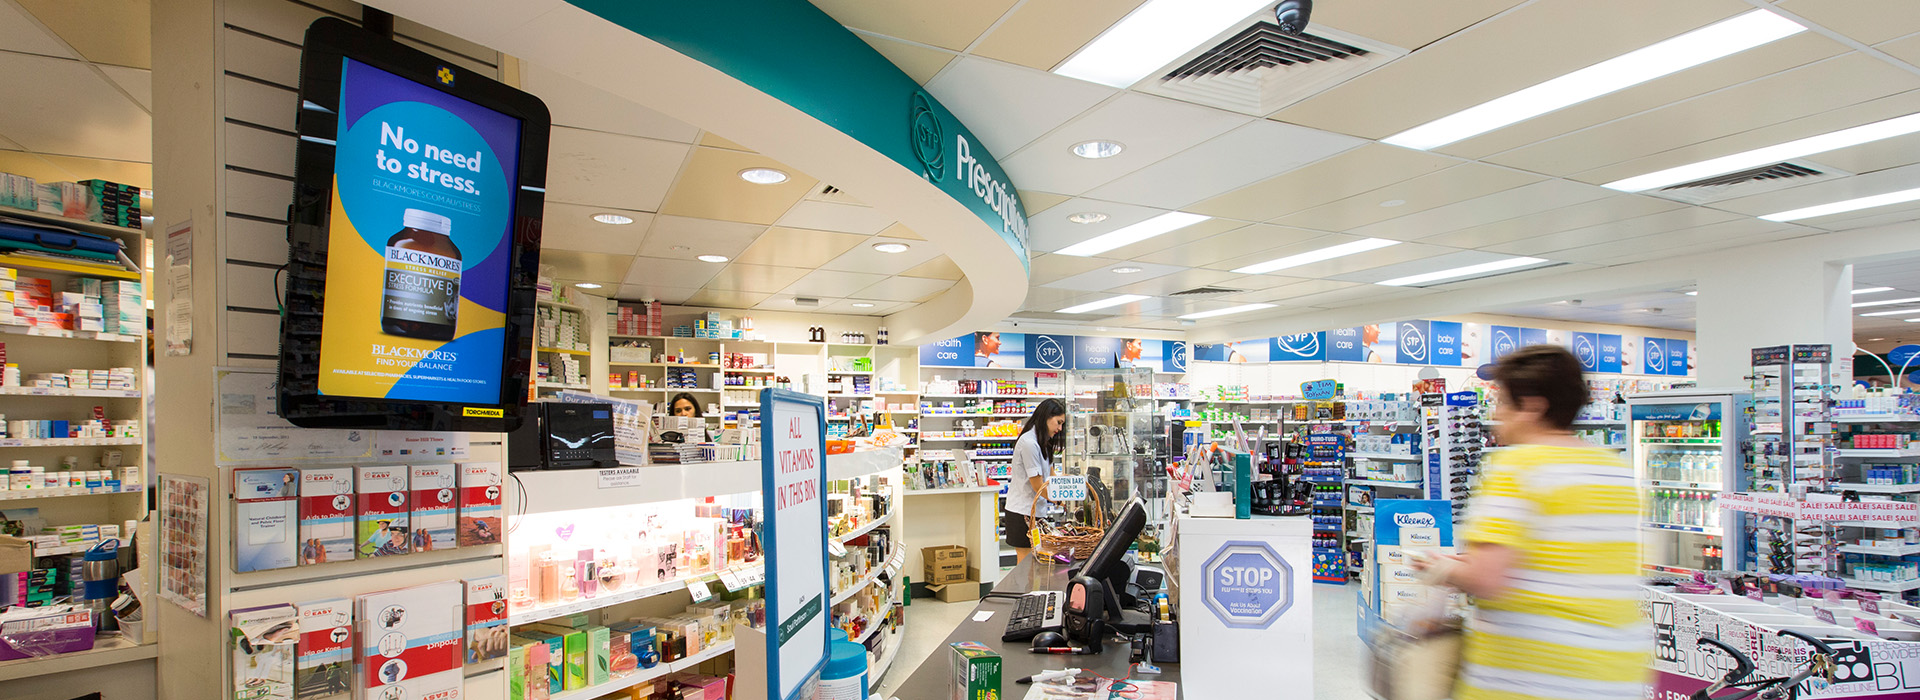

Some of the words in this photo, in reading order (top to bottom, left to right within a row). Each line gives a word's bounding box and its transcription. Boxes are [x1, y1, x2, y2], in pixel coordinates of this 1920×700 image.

[381, 121, 419, 154] No
[424, 144, 482, 173] need
[376, 149, 402, 174] to
[407, 161, 480, 196] stress.
[390, 250, 460, 271] BLACKMORES
[389, 272, 444, 290] EXECUTIVE
[446, 282, 454, 296] B
[405, 284, 434, 294] FORMULA
[1407, 338, 1420, 346] STP
[1438, 334, 1455, 344] baby
[1086, 344, 1110, 353] health
[1336, 340, 1353, 350] care
[1603, 344, 1616, 354] baby
[372, 344, 457, 362] BLACKMORES
[937, 350, 958, 360] care
[1042, 347, 1057, 356] STP
[1438, 347, 1454, 355] care
[1671, 350, 1682, 358] baby
[1089, 356, 1106, 364] care
[1604, 355, 1616, 363] care
[376, 358, 395, 366] FIND
[396, 359, 418, 368] YOUR
[419, 362, 453, 371] BALANCE
[565, 395, 580, 403] Our
[1305, 390, 1330, 399] TOYMAN
[789, 416, 802, 439] ALL
[779, 448, 814, 474] VITAMINS
[778, 485, 787, 511] IN
[788, 481, 803, 506] THIS
[804, 478, 816, 501] BIN
[1052, 490, 1057, 498] 3
[1059, 490, 1073, 498] FOR
[1076, 490, 1084, 498] $6
[1397, 515, 1434, 527] Kleenex
[1220, 566, 1273, 587] STOP
[426, 639, 458, 650] Product
[1874, 661, 1920, 691] BL
